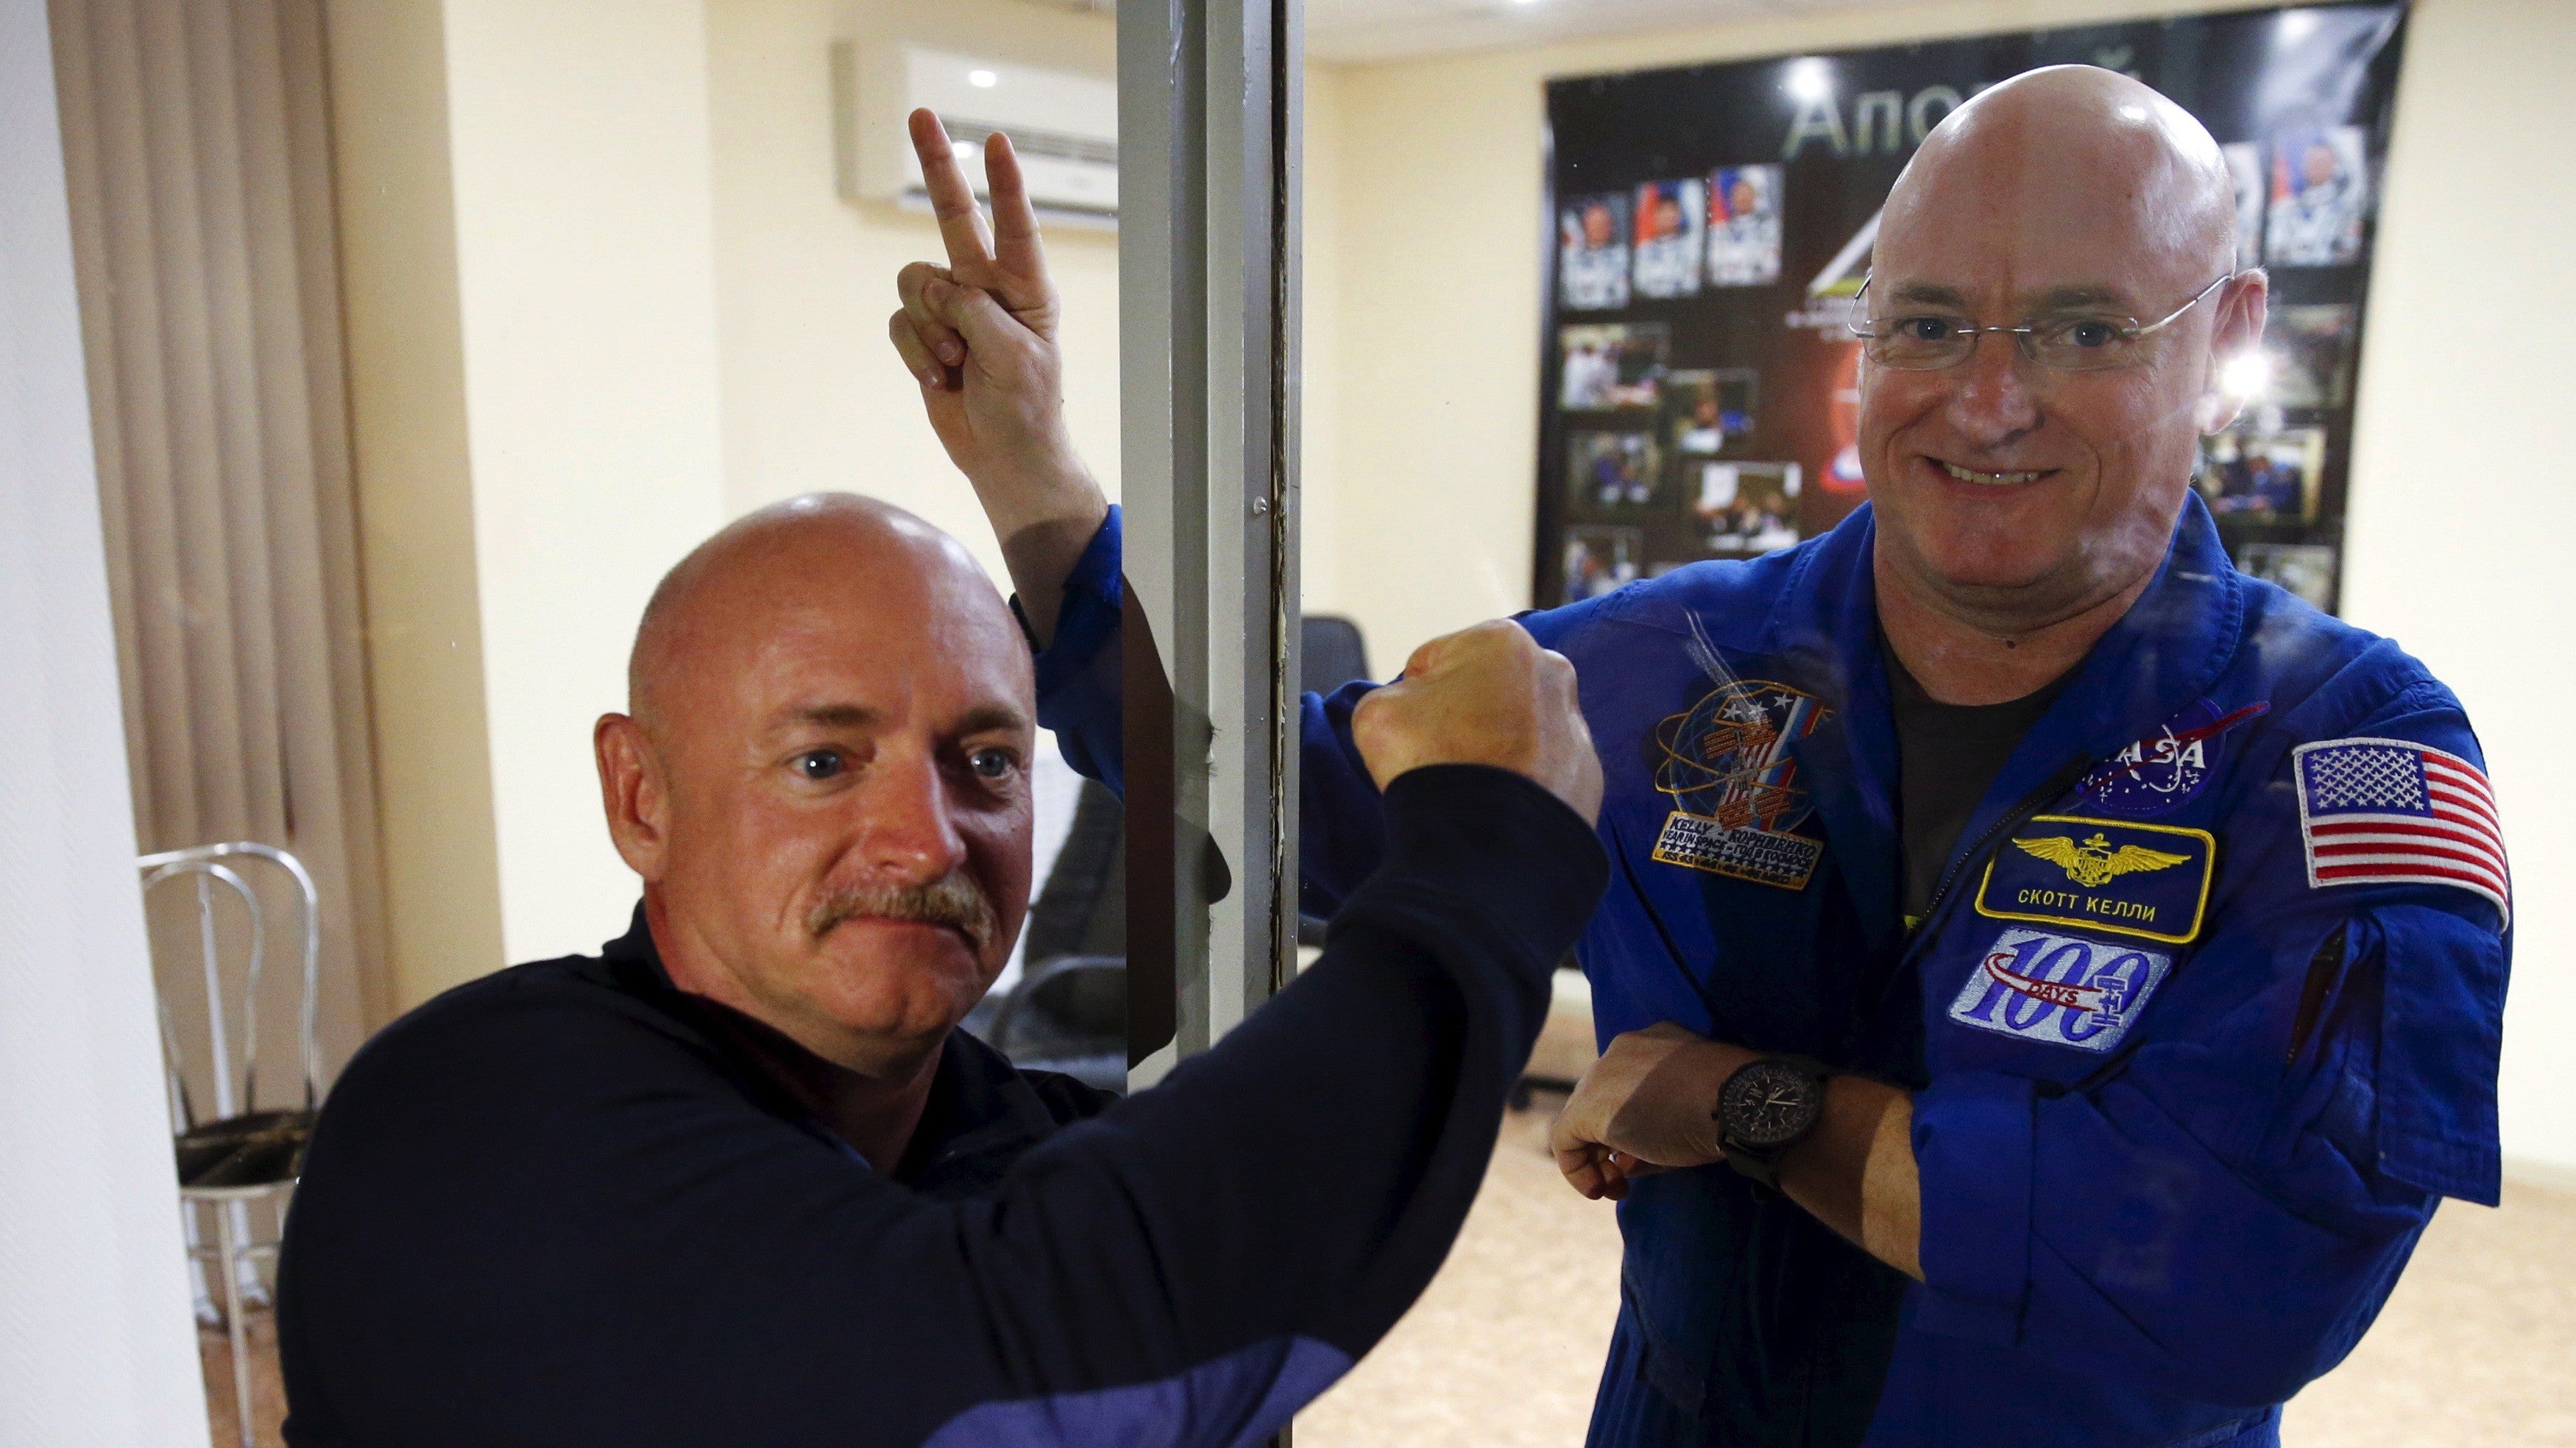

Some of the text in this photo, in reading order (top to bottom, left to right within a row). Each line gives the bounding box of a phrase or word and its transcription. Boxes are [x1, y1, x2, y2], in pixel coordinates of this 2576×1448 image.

[2105, 738, 2207, 770] ASA
[1669, 817, 1715, 836] KELLY
[2018, 890, 2156, 922] СКОТТ КЕЛЛИ
[1961, 937, 2150, 1041] 100
[2025, 983, 2078, 1004] DAYS
